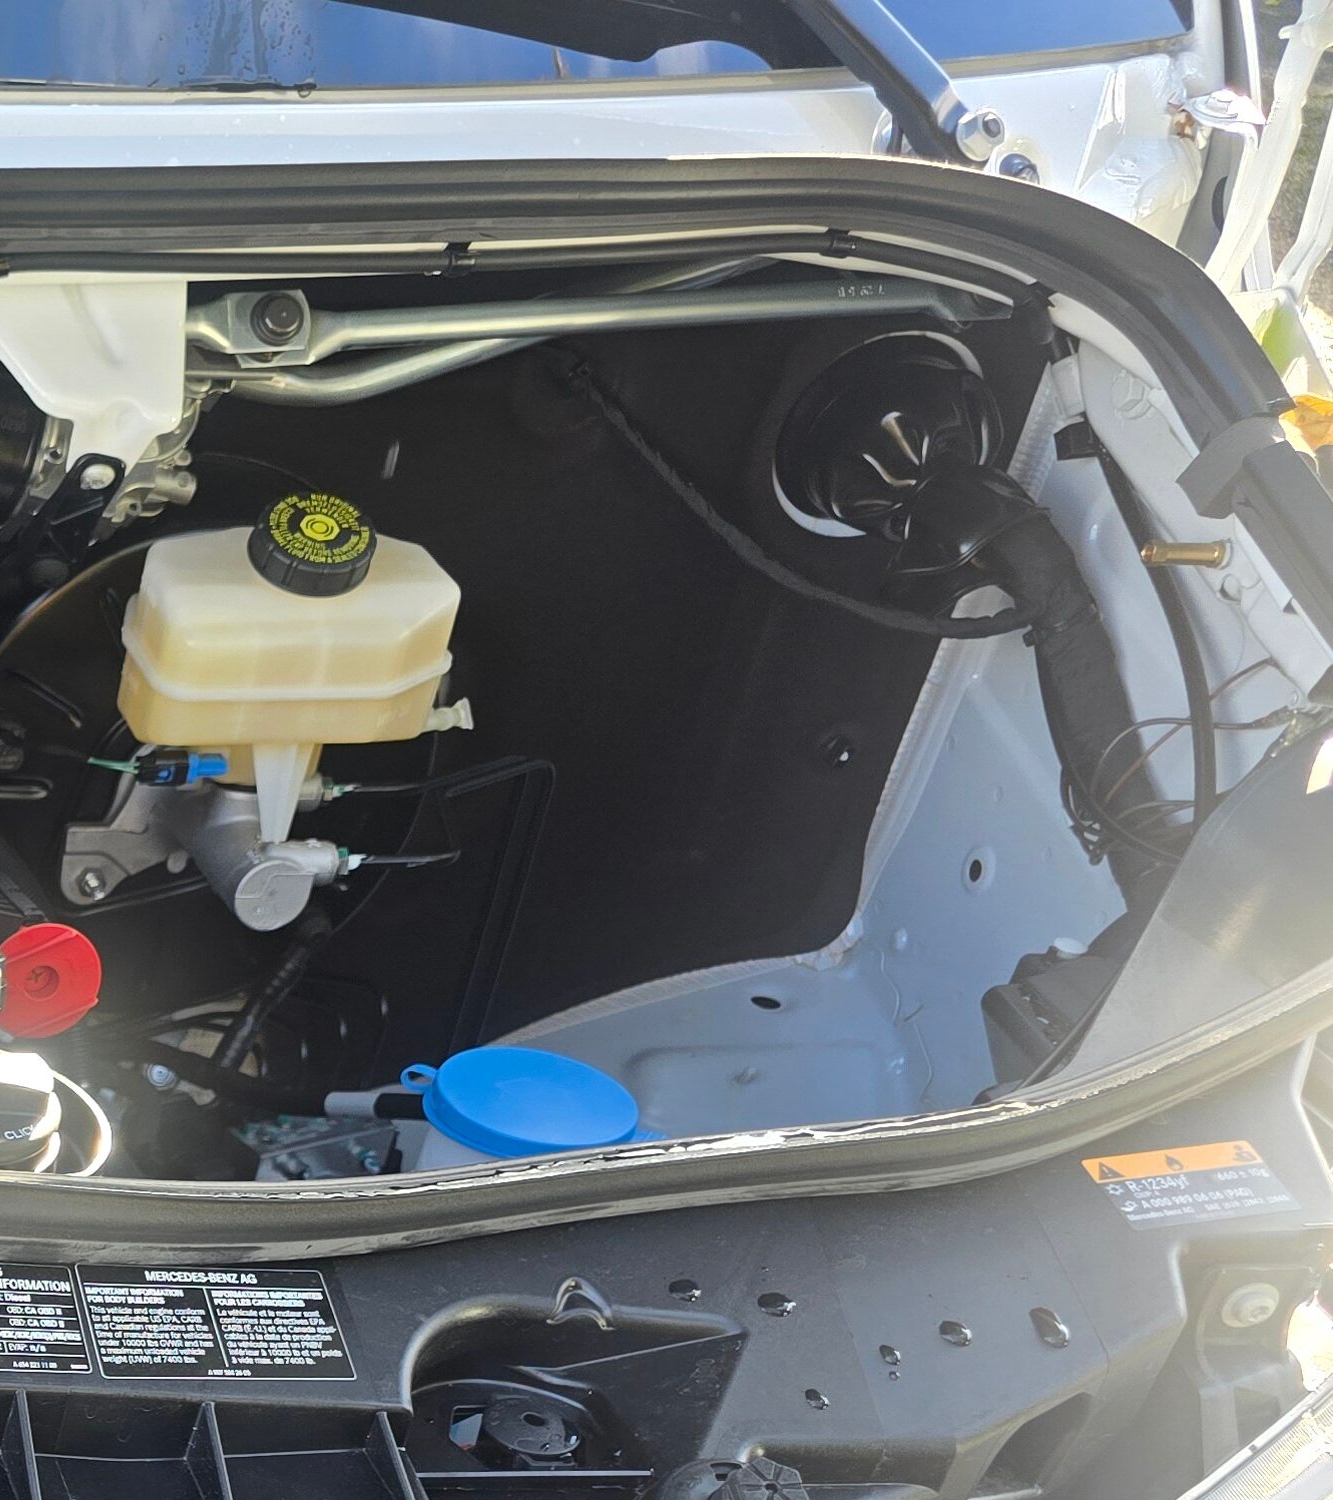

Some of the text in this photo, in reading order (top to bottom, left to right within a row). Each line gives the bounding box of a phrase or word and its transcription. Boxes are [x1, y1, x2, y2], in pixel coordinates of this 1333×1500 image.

[1125, 1174, 1190, 1192] R-1234yf
[1151, 1198, 1172, 1208] 000
[144, 1270, 258, 1284] MERCEDES-BENZ AG
[25, 1307, 37, 1315] CA
[27, 1319, 40, 1327] CA
